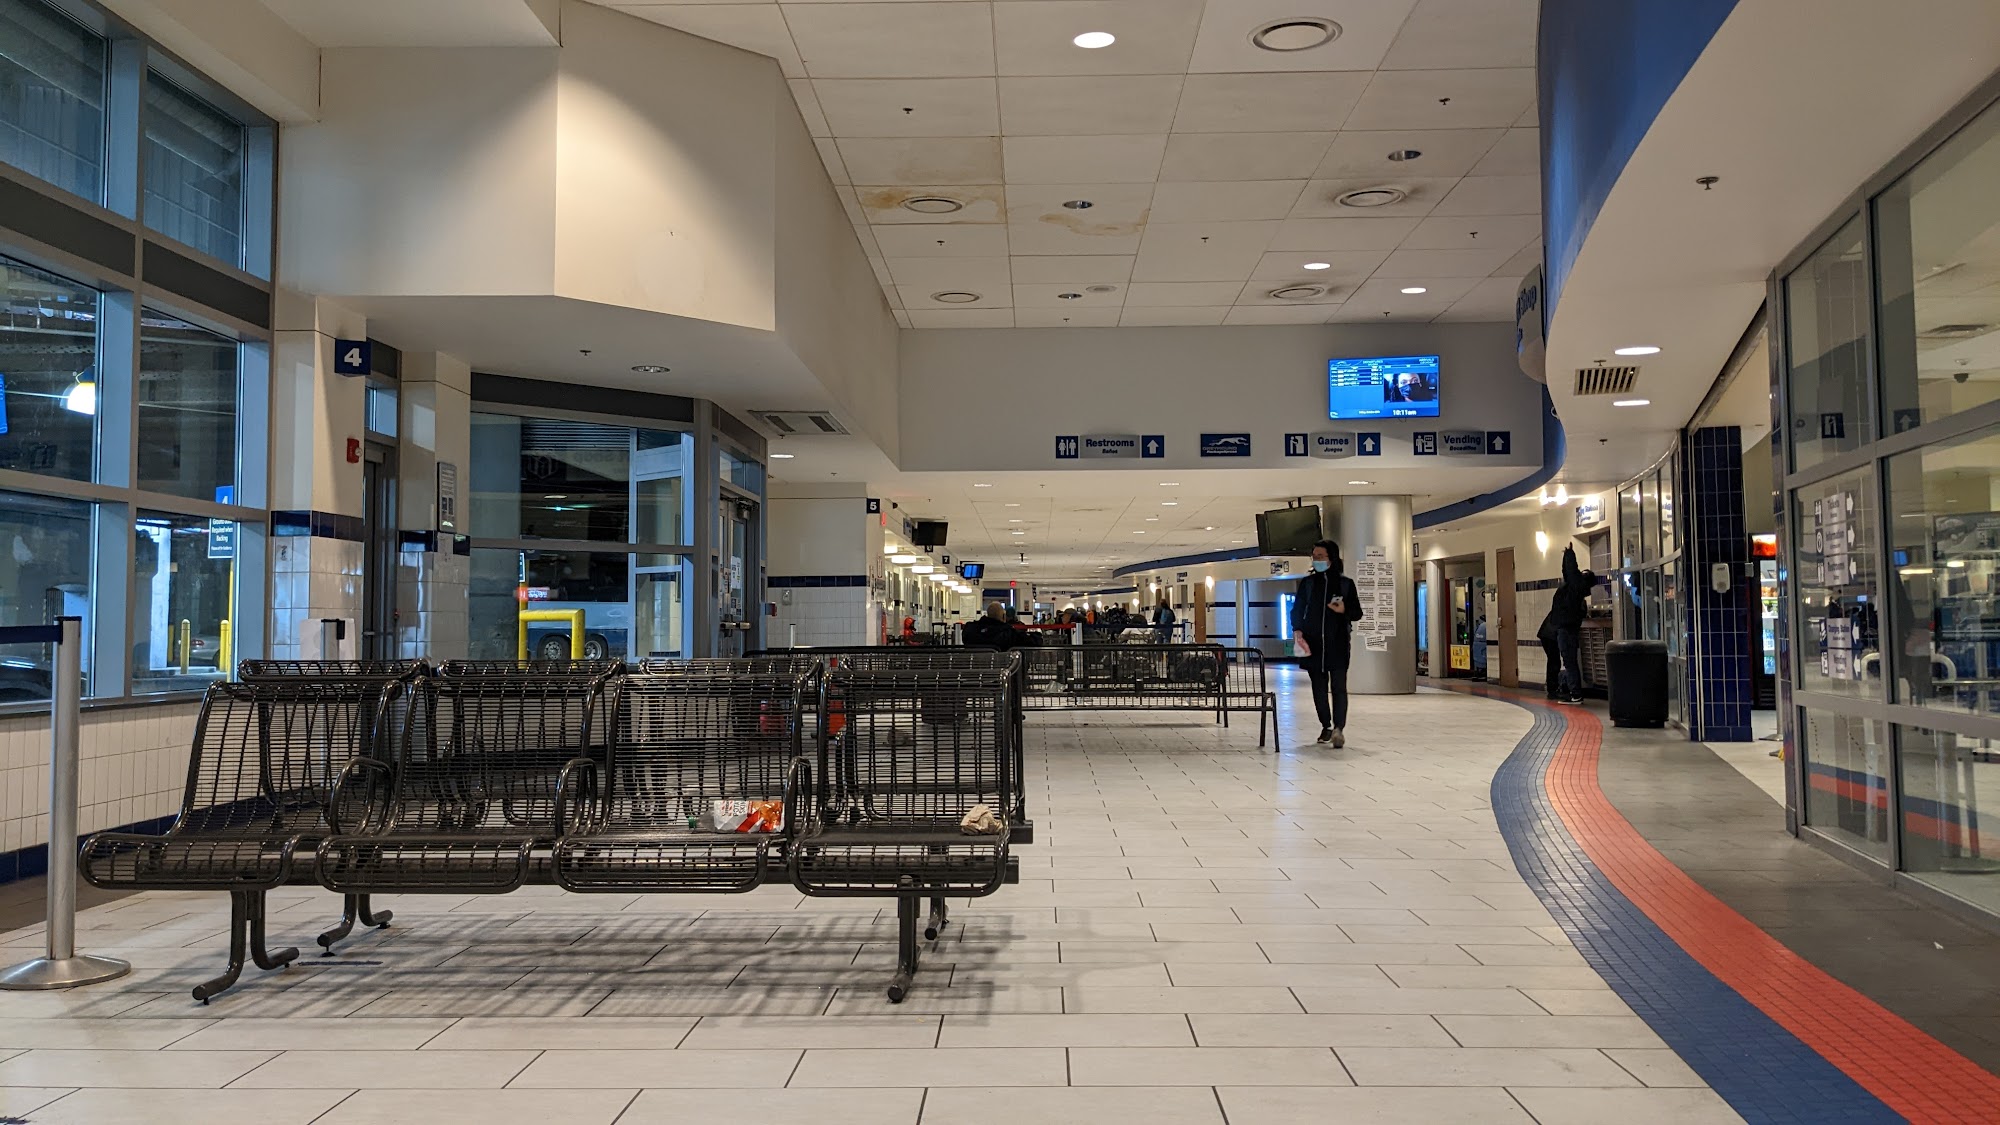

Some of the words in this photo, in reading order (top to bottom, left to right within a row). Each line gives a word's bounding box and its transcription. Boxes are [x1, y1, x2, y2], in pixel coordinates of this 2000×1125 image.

[344, 348, 362, 367] 4
[1085, 438, 1134, 448] Restrooms
[1317, 436, 1349, 445] Games
[1443, 435, 1482, 446] Vending
[869, 501, 877, 511] 5
